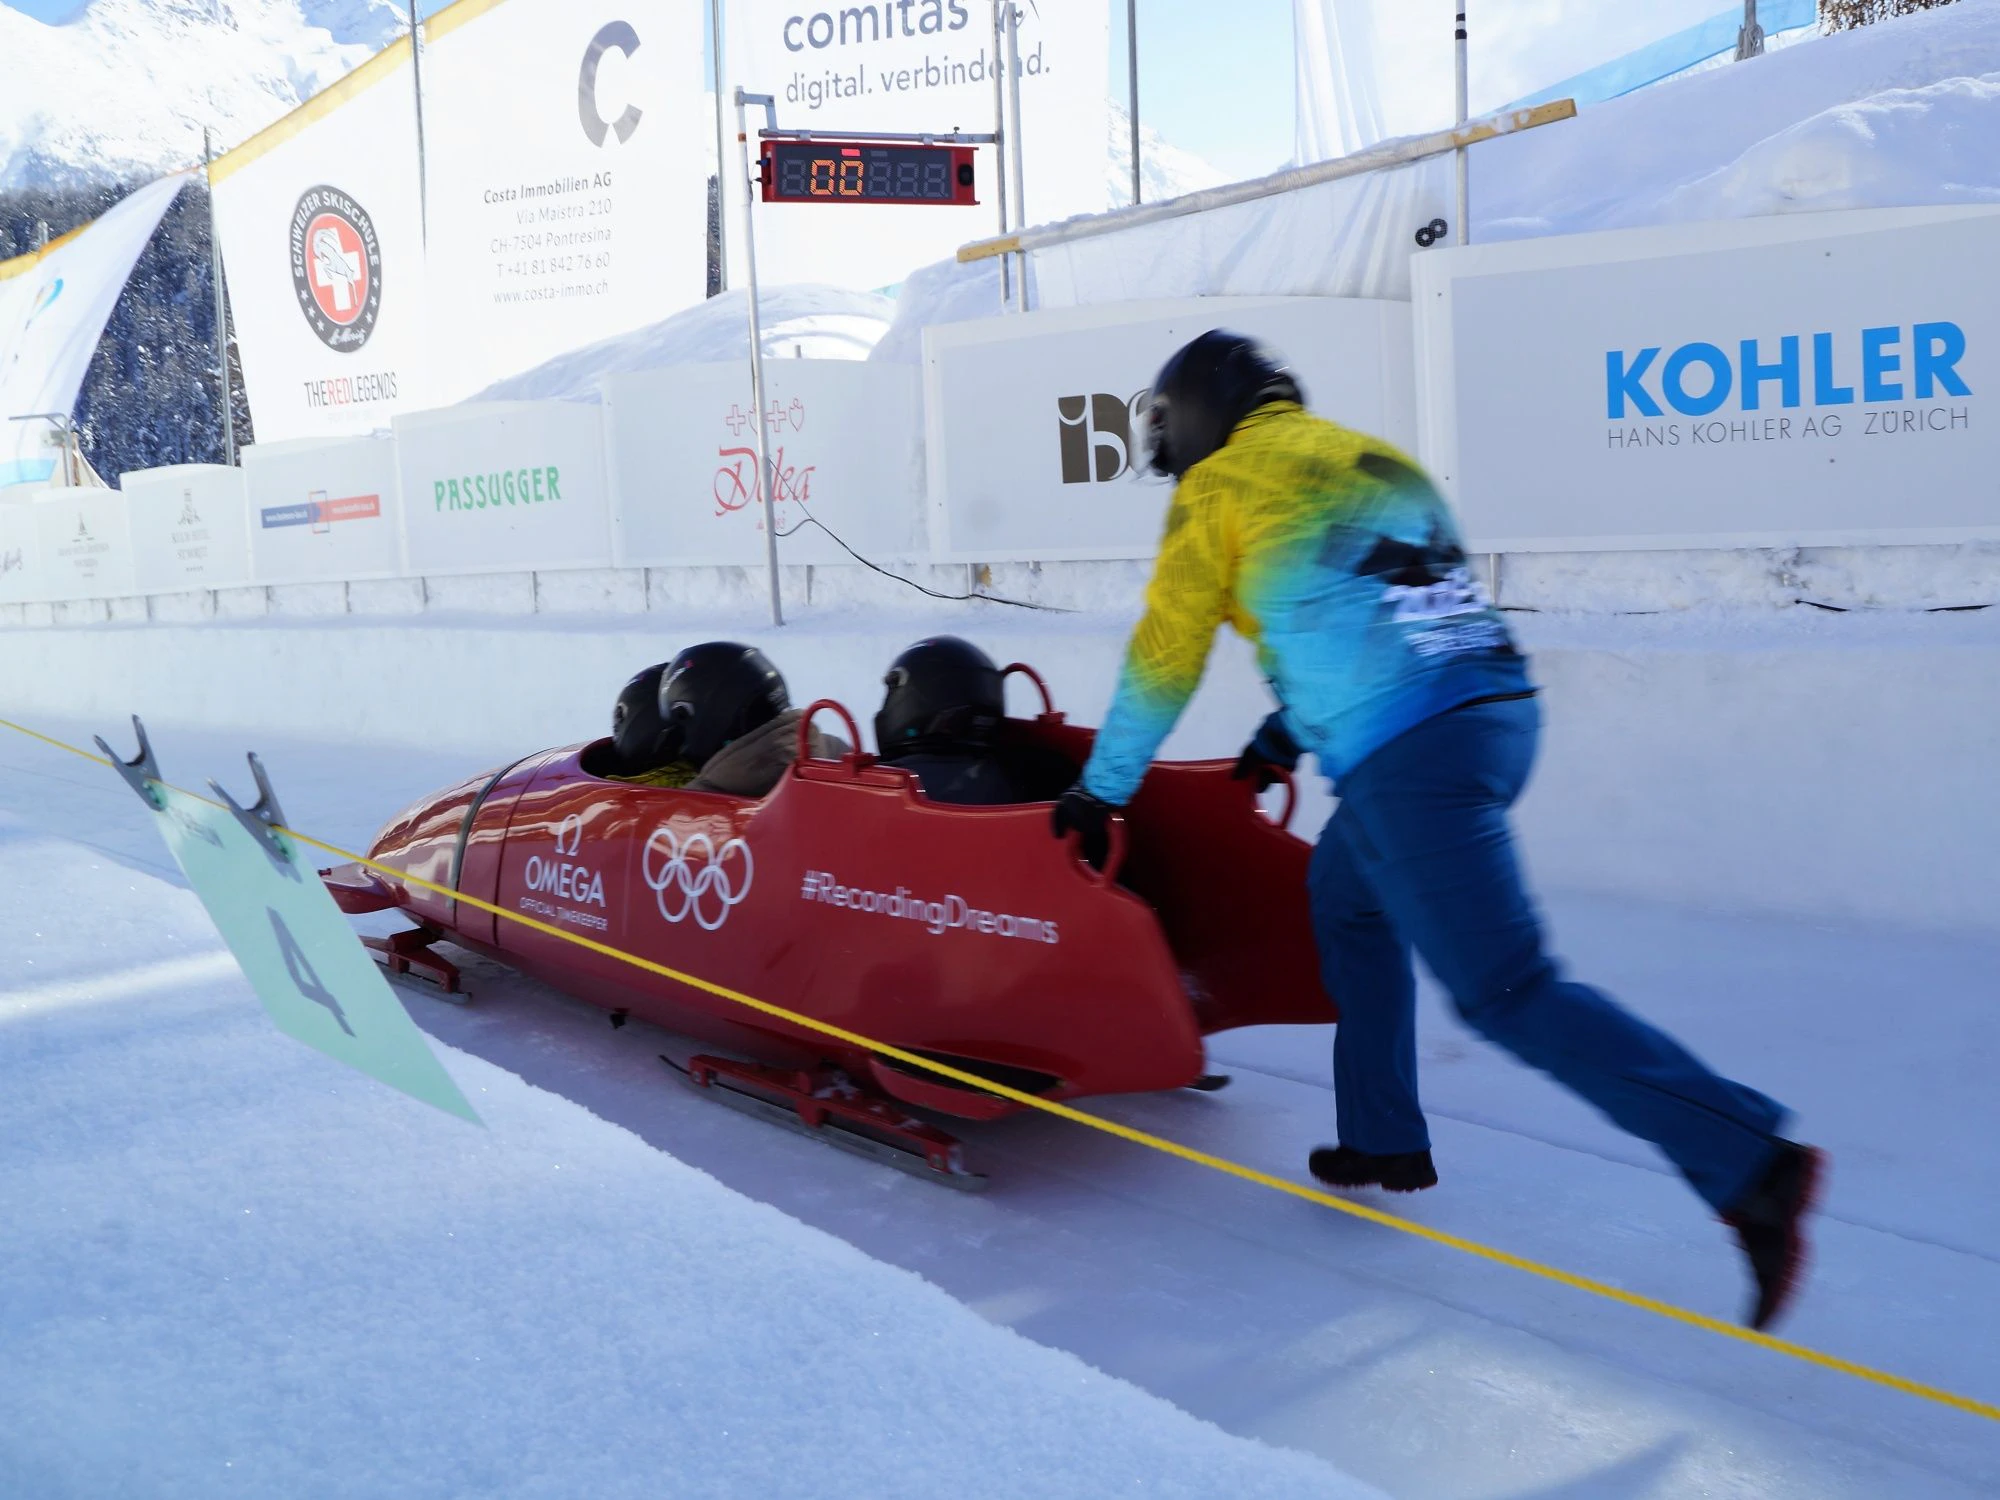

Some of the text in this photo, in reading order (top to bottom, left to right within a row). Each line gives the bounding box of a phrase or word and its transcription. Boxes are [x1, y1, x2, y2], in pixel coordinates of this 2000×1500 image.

[783, 0, 968, 52] comitas
[786, 64, 872, 109] digital.
[484, 171, 612, 204] Costa Immobilien AG
[516, 198, 612, 224] Via Maistra 210
[292, 191, 379, 278] SCHWEIZER SKISCHULE
[490, 227, 611, 254] CH-7504 Pontresina
[496, 263, 504, 278] T
[508, 261, 527, 276] +41
[550, 255, 573, 273] 842
[493, 279, 609, 304] www.costa-immo.ch
[304, 371, 397, 408] THEREDLEGENDS
[1606, 321, 1973, 419] KOHLER
[1608, 407, 1969, 449] HANS KOHLER AG ZÜRICH
[434, 466, 562, 512] PASSUGGER
[525, 855, 606, 908] OMEGA
[520, 897, 556, 917] OFFICIAL
[801, 870, 1059, 943] #RecordingDreams
[266, 906, 357, 1038] 4
